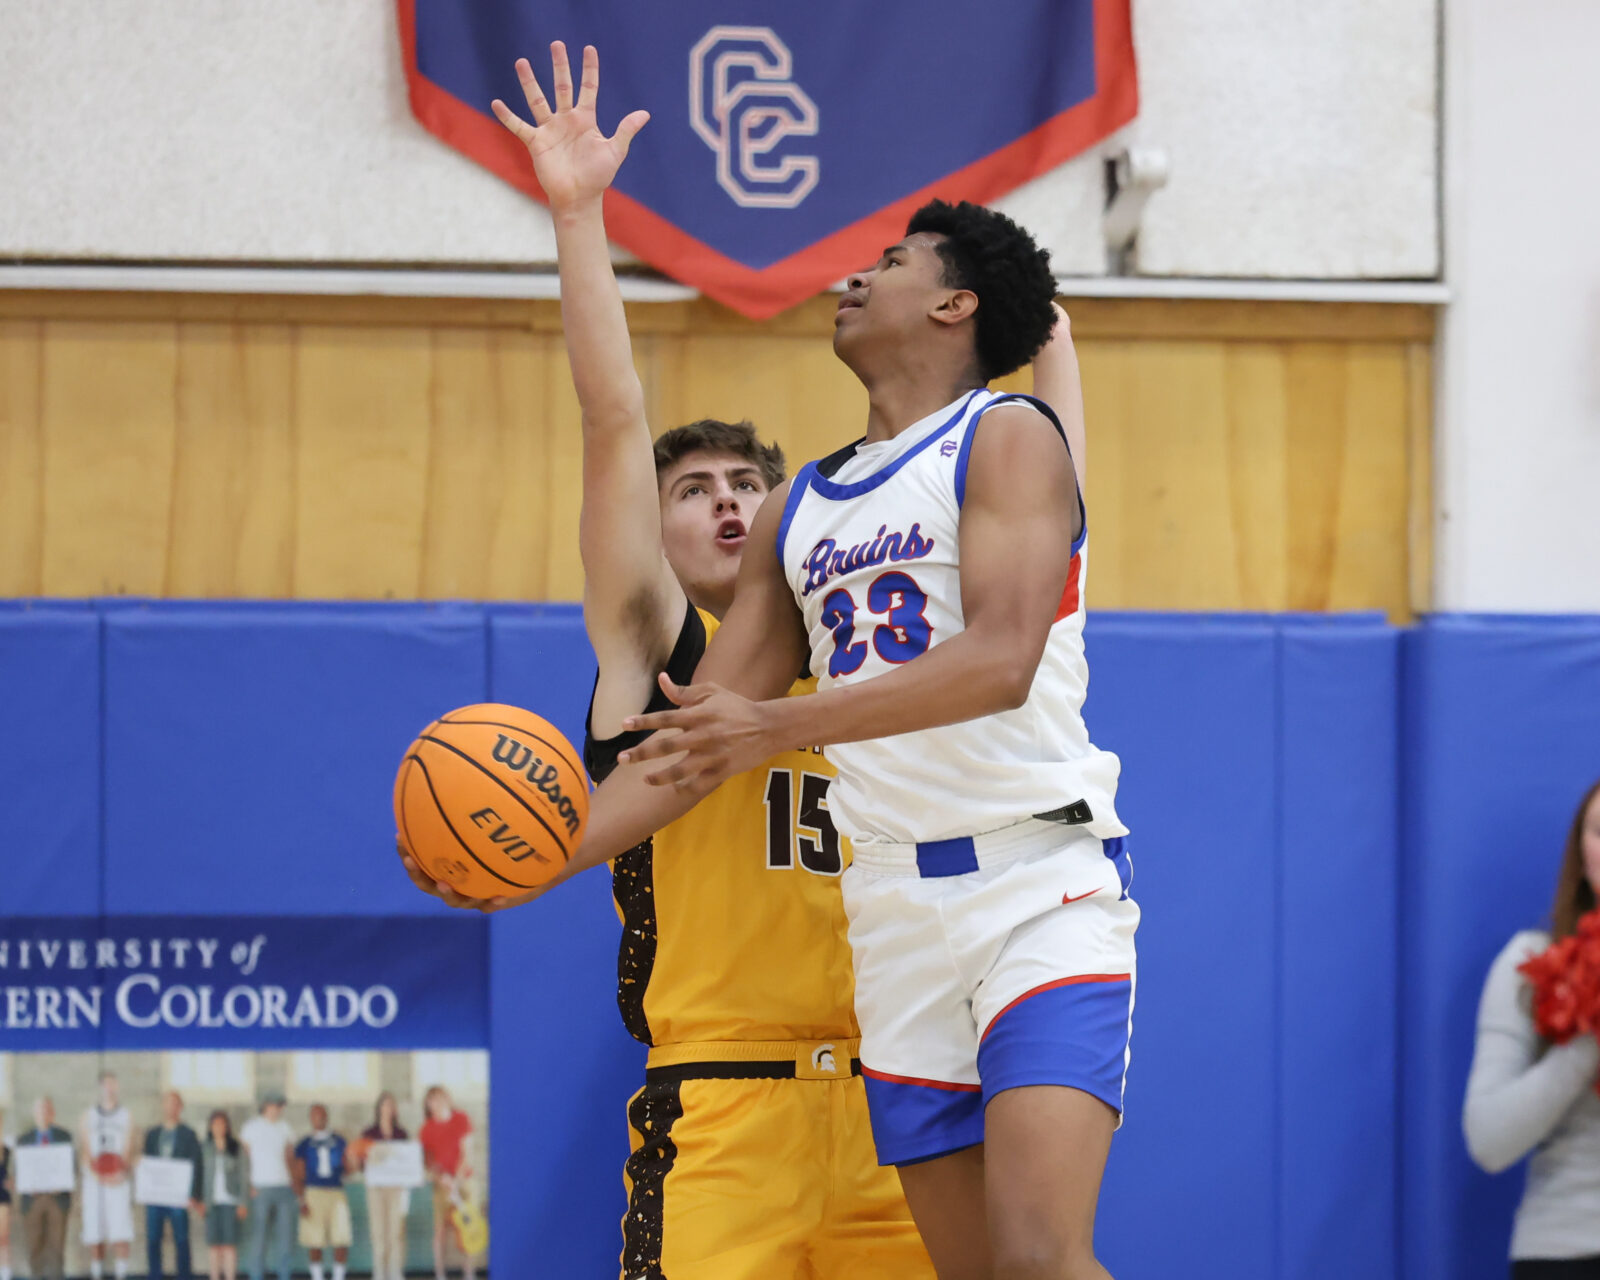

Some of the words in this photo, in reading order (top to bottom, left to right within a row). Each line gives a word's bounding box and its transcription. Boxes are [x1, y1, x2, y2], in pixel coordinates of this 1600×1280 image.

[802, 522, 935, 596] Bruins
[820, 570, 935, 679] 23
[492, 733, 580, 839] Wilson
[763, 768, 844, 876] 15
[1074, 809, 1083, 819] L
[230, 934, 267, 976] of
[0, 986, 102, 1029] ERN
